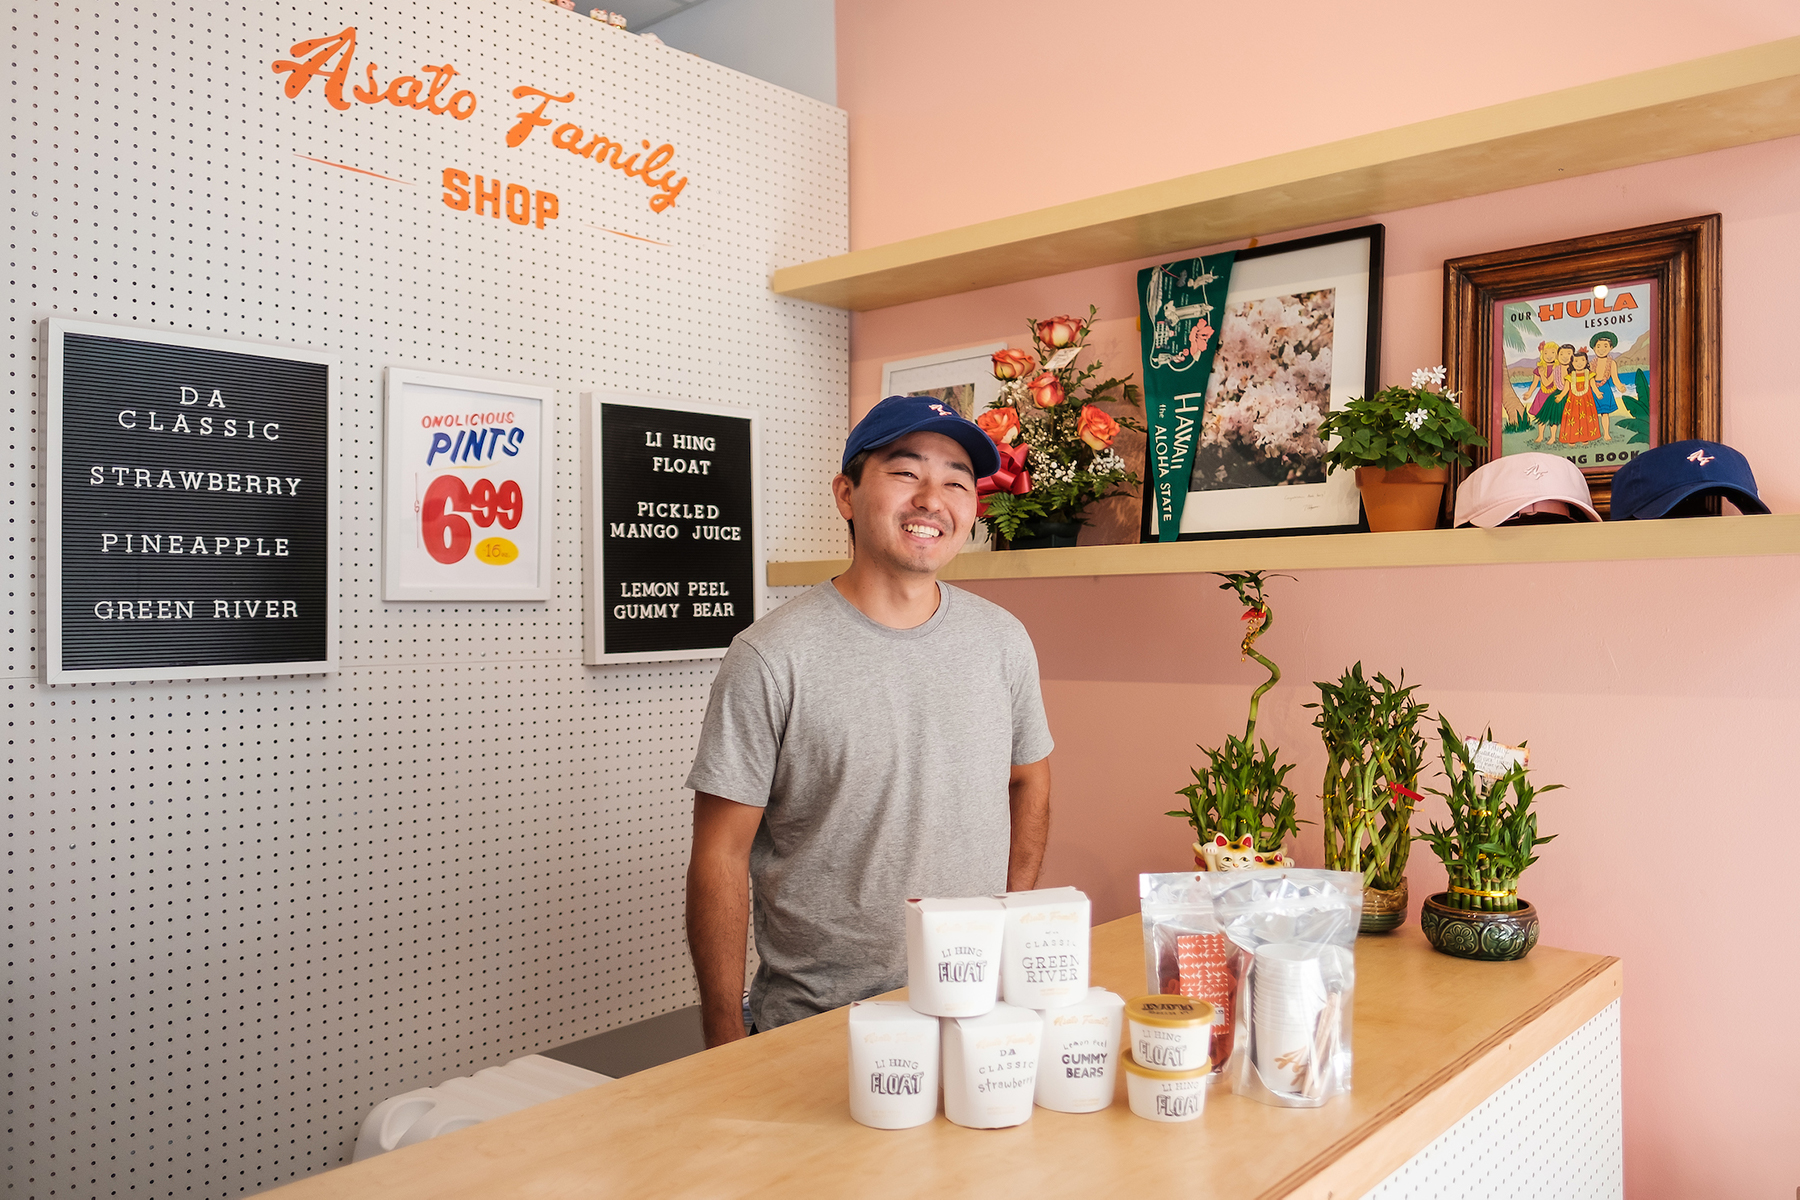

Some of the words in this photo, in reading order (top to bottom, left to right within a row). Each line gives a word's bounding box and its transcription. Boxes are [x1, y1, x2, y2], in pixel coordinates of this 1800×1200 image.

[271, 26, 477, 121] Asato
[505, 84, 688, 214] Family
[442, 167, 559, 230] SHOP
[1510, 311, 1532, 323] OUR
[1538, 292, 1638, 322] HULA
[1584, 313, 1633, 329] LESSONS
[180, 386, 226, 408] DA
[118, 410, 280, 441] CLASSIC
[421, 411, 515, 429] ONOLICIOUS
[1170, 392, 1202, 470] HAWAII
[426, 427, 525, 467] PINTS
[645, 431, 662, 448] LI
[672, 434, 716, 452] HING
[1154, 425, 1170, 478] ALOHA
[652, 456, 712, 475] FLOAT
[90, 466, 302, 497] STRAWBERRY
[637, 501, 720, 520] PICKLED
[1160, 482, 1172, 522] STATE
[610, 522, 679, 539] MANGO
[692, 525, 741, 541] JUICE
[100, 533, 289, 557] PINEAPPLE
[621, 581, 679, 598] LEMON
[688, 582, 729, 597] PEEL
[94, 600, 194, 621] GREEN
[213, 599, 298, 620] RIVER
[613, 603, 680, 620] GUMMY
[692, 602, 735, 618] BEAR
[941, 948, 952, 958] LI
[955, 946, 983, 958] HING
[938, 960, 987, 983] FLOAT
[1022, 955, 1080, 970] GREEN
[1026, 968, 1078, 983] RIVER
[1154, 1030, 1182, 1043] HING
[999, 1048, 1017, 1057] DA
[1061, 1053, 1108, 1065] GUMMY
[1138, 1039, 1187, 1067] FLOAT
[875, 1059, 885, 1069] LI
[889, 1058, 919, 1070] HING
[978, 1060, 1034, 1075] CLASSIC
[1066, 1067, 1104, 1079] BEARS
[871, 1071, 925, 1096] FLOAT
